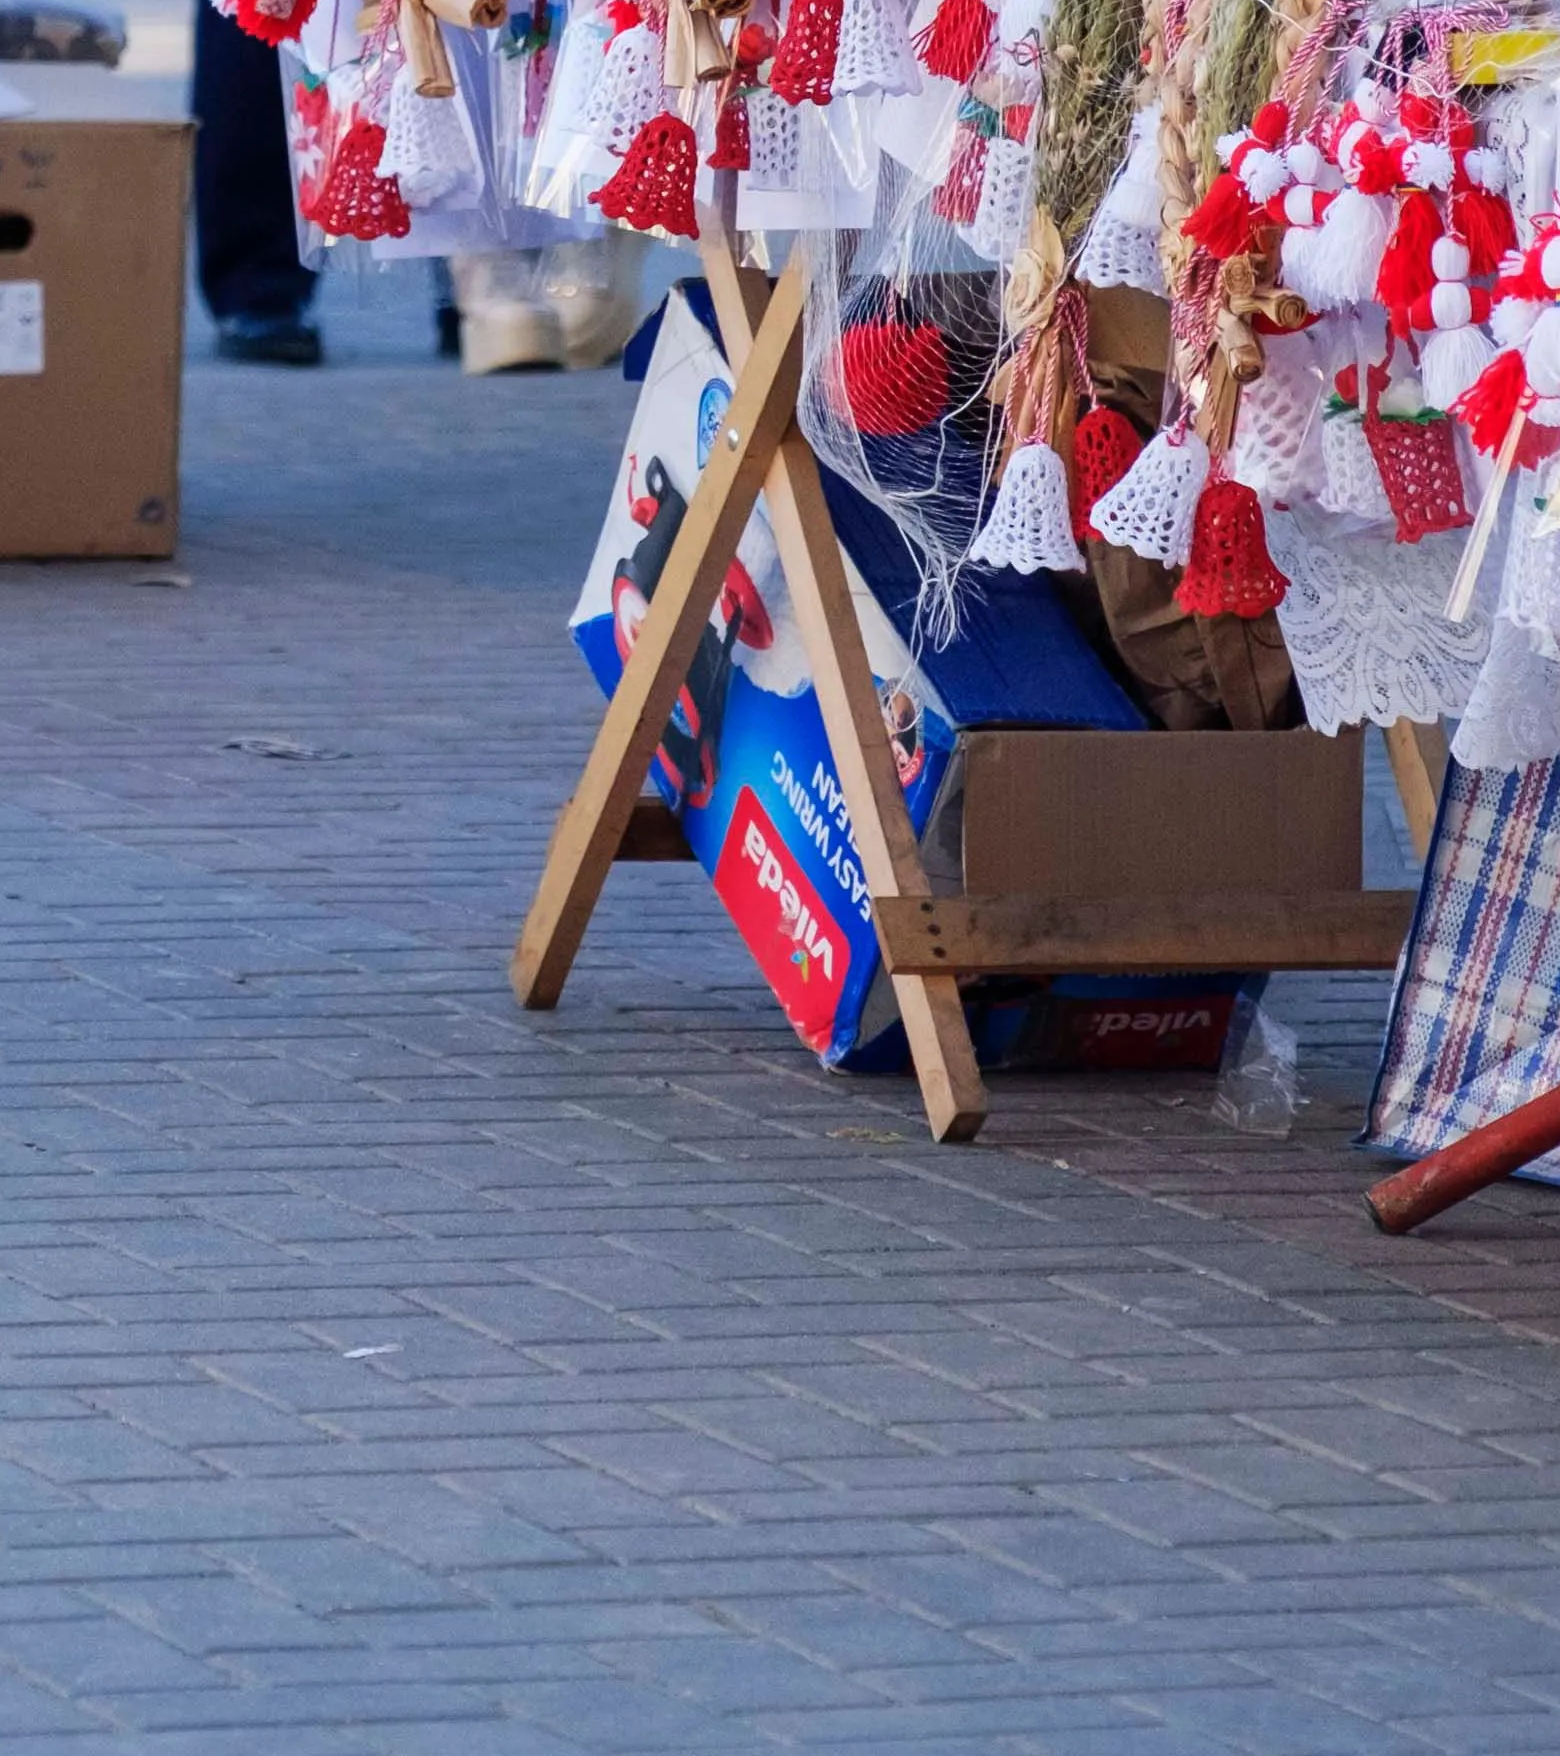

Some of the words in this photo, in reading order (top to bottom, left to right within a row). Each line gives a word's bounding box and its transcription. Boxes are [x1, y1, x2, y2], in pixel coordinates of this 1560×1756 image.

[744, 819, 833, 981] vileda
[828, 846, 873, 923] EASY
[1094, 1010, 1212, 1037] viled
